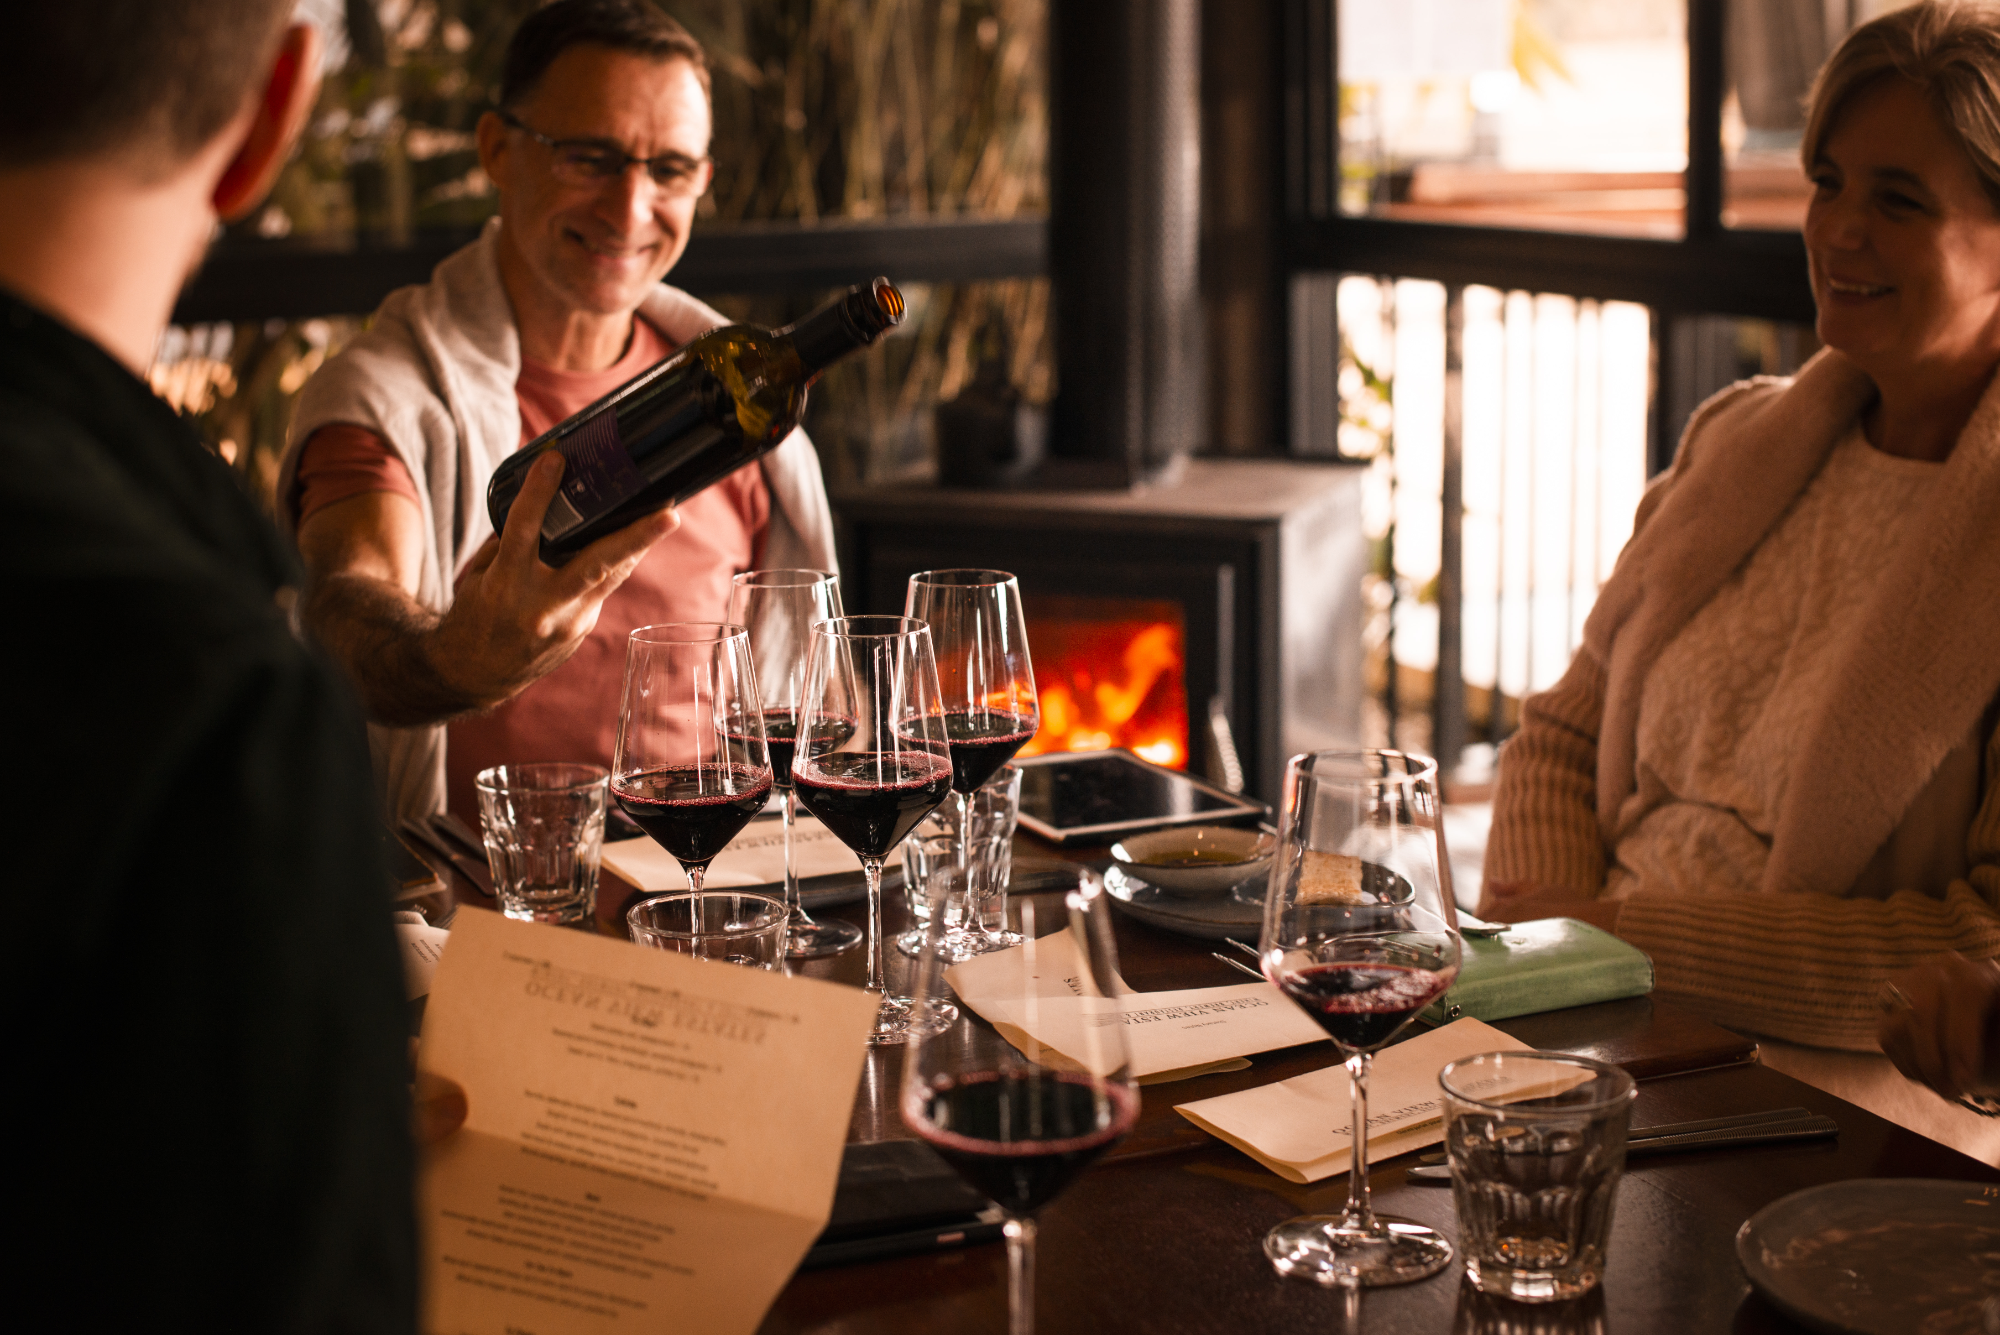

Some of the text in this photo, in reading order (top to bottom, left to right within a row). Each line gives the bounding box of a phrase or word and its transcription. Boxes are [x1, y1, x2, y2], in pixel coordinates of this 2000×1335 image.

[1211, 1001, 1269, 1013] OCEAN
[1166, 1009, 1210, 1020] VIEW
[1332, 1113, 1391, 1134] OCAN
